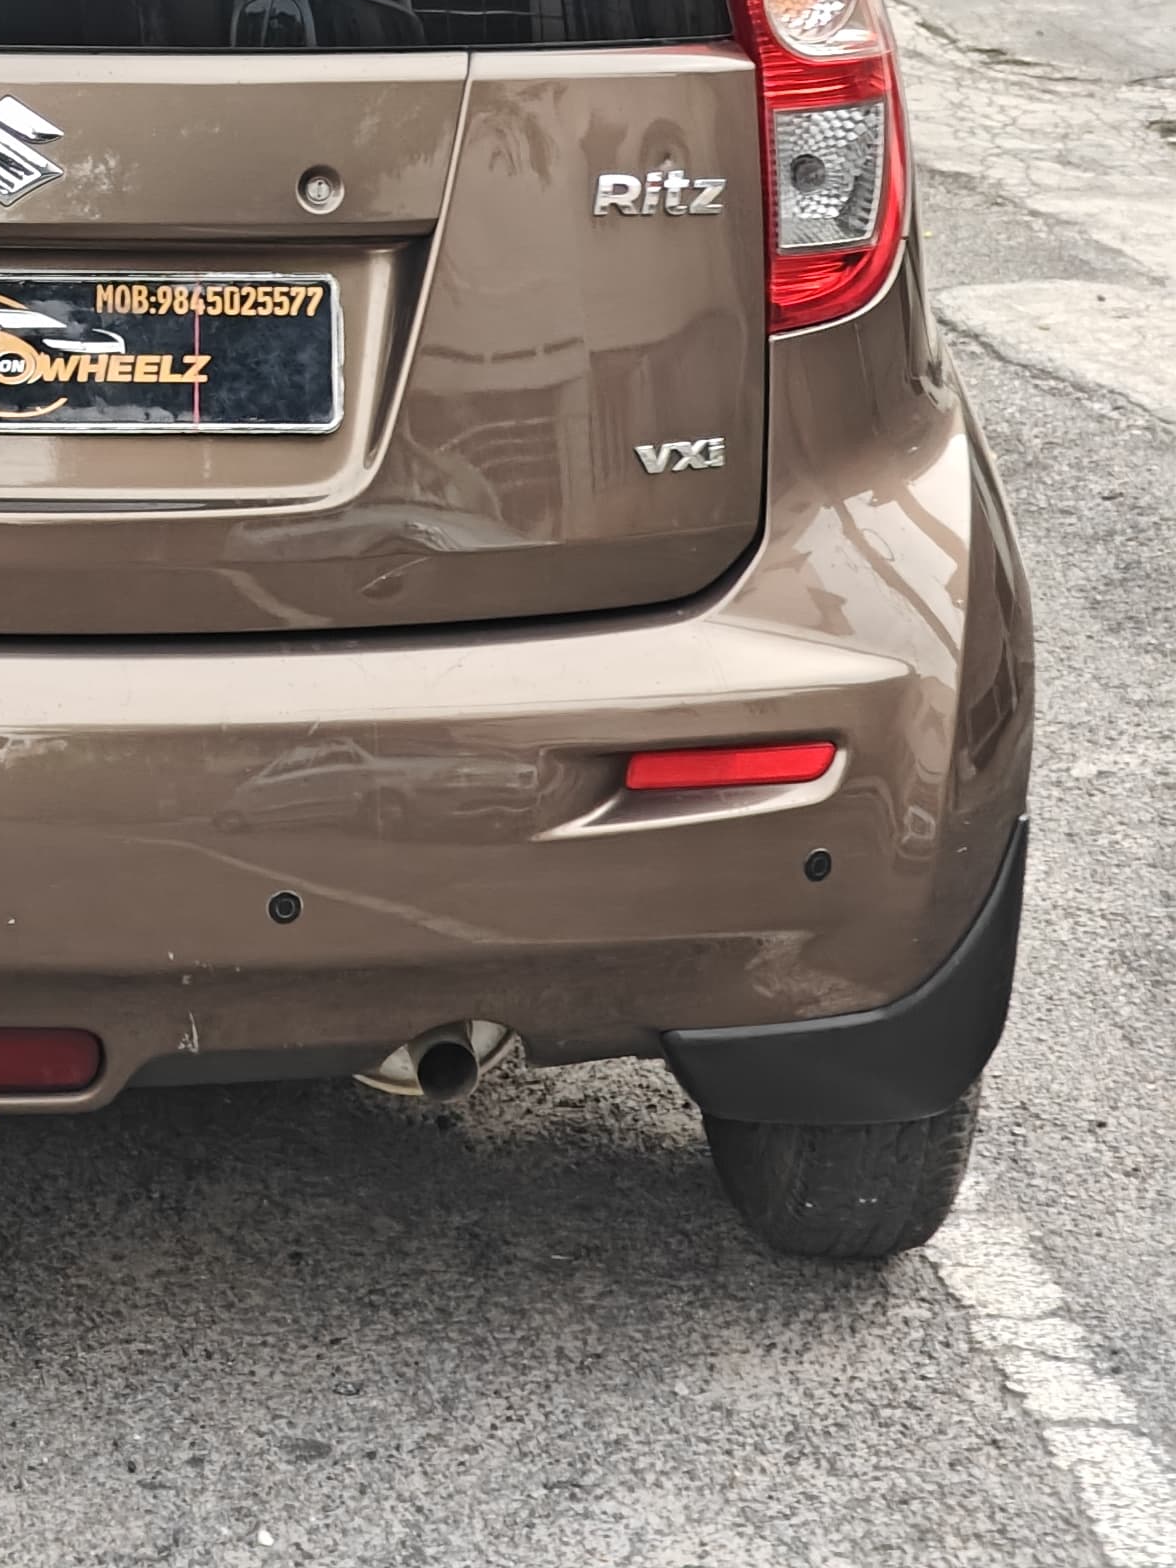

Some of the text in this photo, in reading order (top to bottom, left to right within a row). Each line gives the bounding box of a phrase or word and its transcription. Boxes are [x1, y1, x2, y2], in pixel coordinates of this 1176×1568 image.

[593, 170, 727, 216] Ritz
[96, 284, 323, 317] MOB:9845025577
[37, 352, 212, 383] WHEELZ
